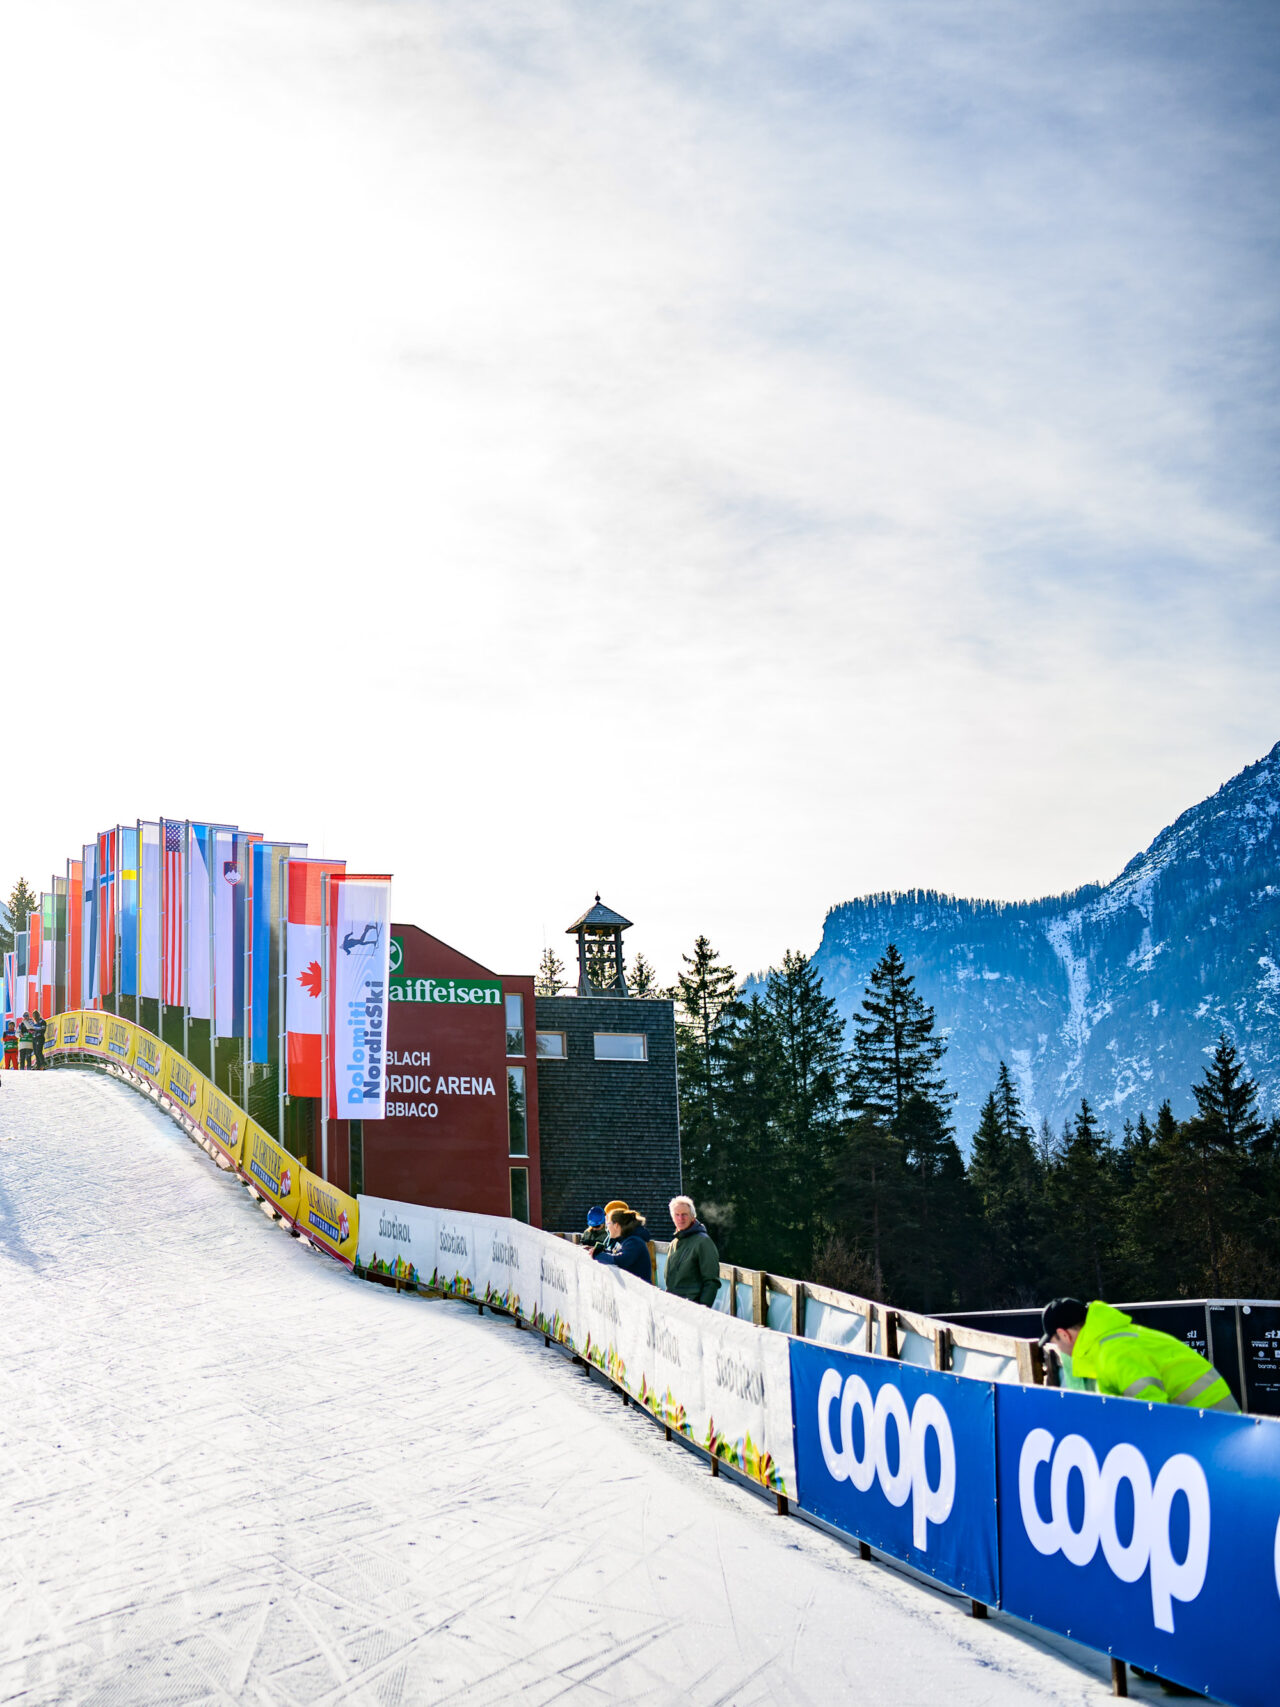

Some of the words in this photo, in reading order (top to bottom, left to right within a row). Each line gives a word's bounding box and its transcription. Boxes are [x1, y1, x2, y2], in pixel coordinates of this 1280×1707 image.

[389, 980, 502, 1004] aiffeisen
[347, 1002, 366, 1104] Dolomiti
[363, 981, 384, 1099] NordicSki
[386, 1051, 431, 1066] BLACH
[386, 1102, 439, 1118] BBIACO
[435, 1076, 496, 1096] ARENA
[818, 1368, 956, 1552] coop
[1019, 1429, 1210, 1633] coop
